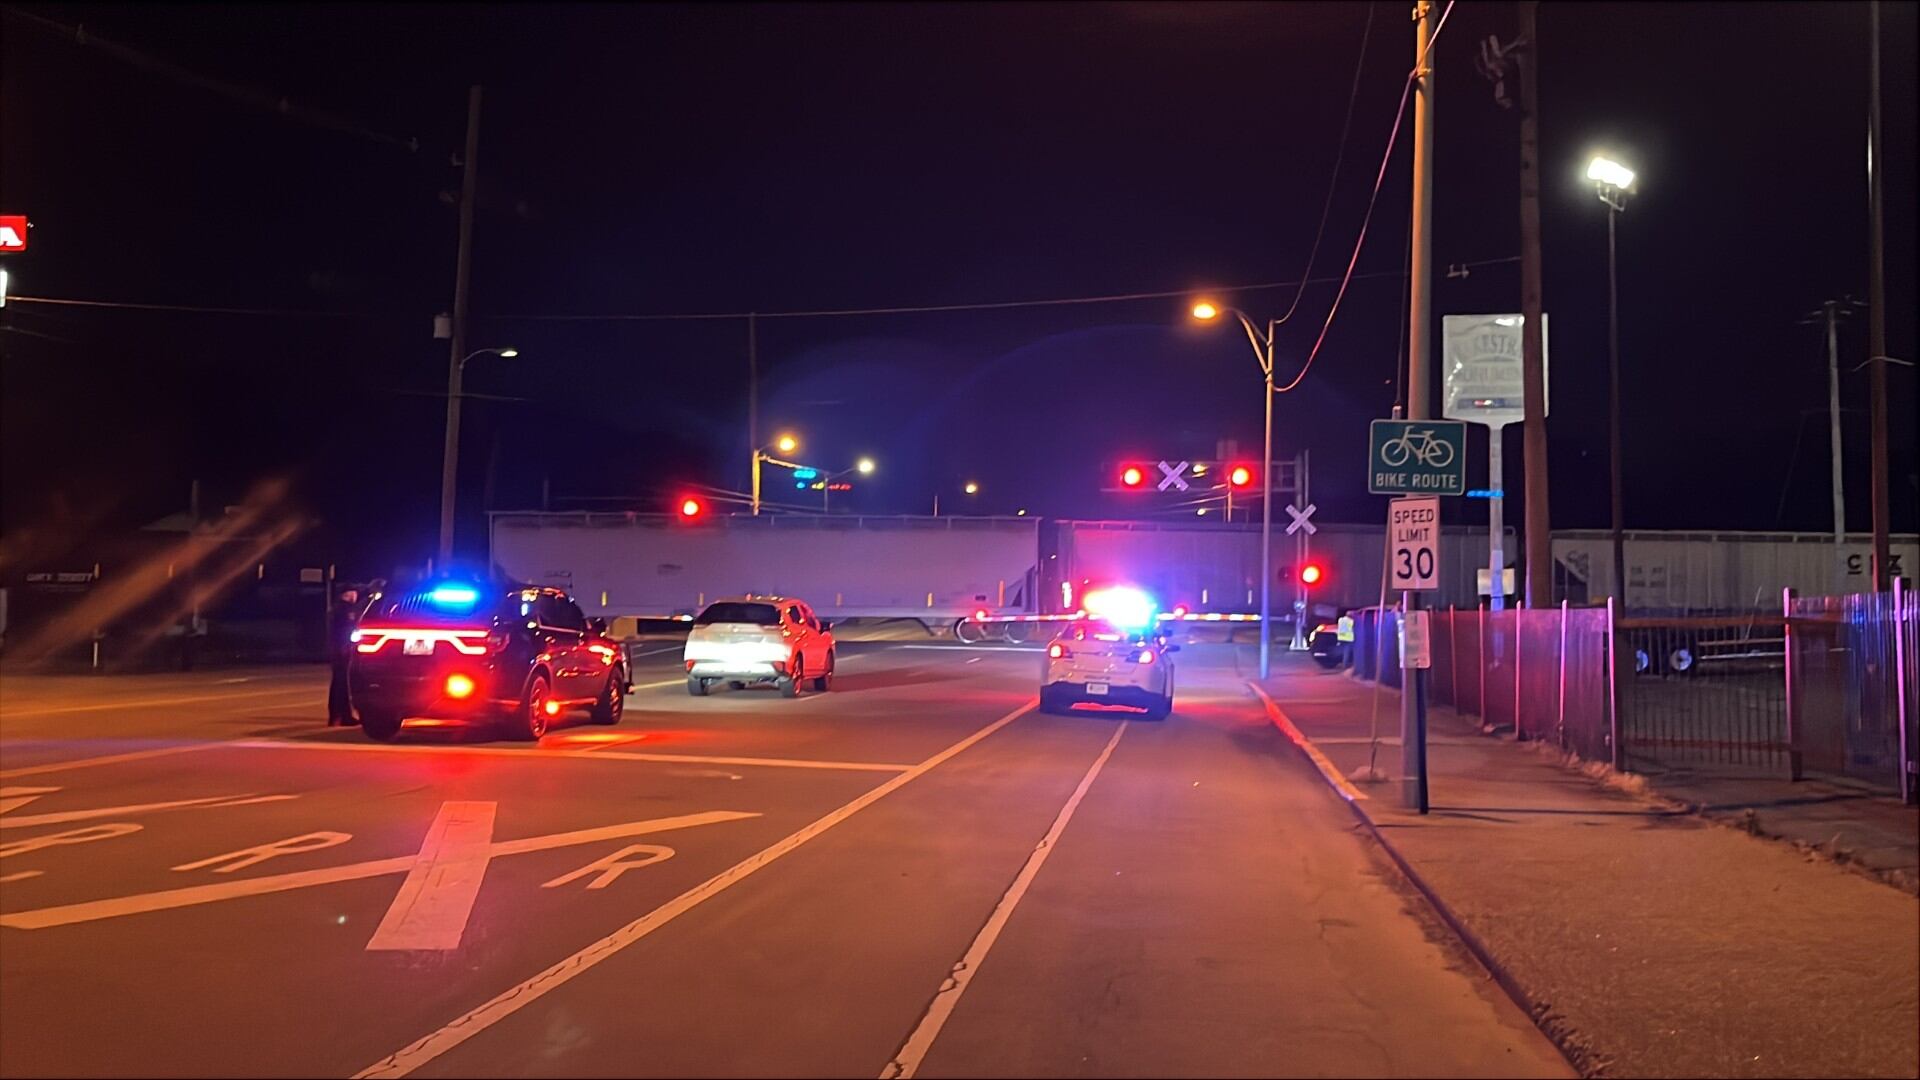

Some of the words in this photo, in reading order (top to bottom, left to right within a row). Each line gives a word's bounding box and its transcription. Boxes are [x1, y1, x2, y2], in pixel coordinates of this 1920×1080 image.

[1375, 472, 1407, 487] BIKE
[1412, 473, 1458, 488] ROUTE
[1394, 508, 1434, 524] SPEED
[1398, 528, 1430, 543] LIMIT
[1396, 547, 1434, 580] 30
[170, 831, 353, 873] R
[541, 844, 676, 890] R
